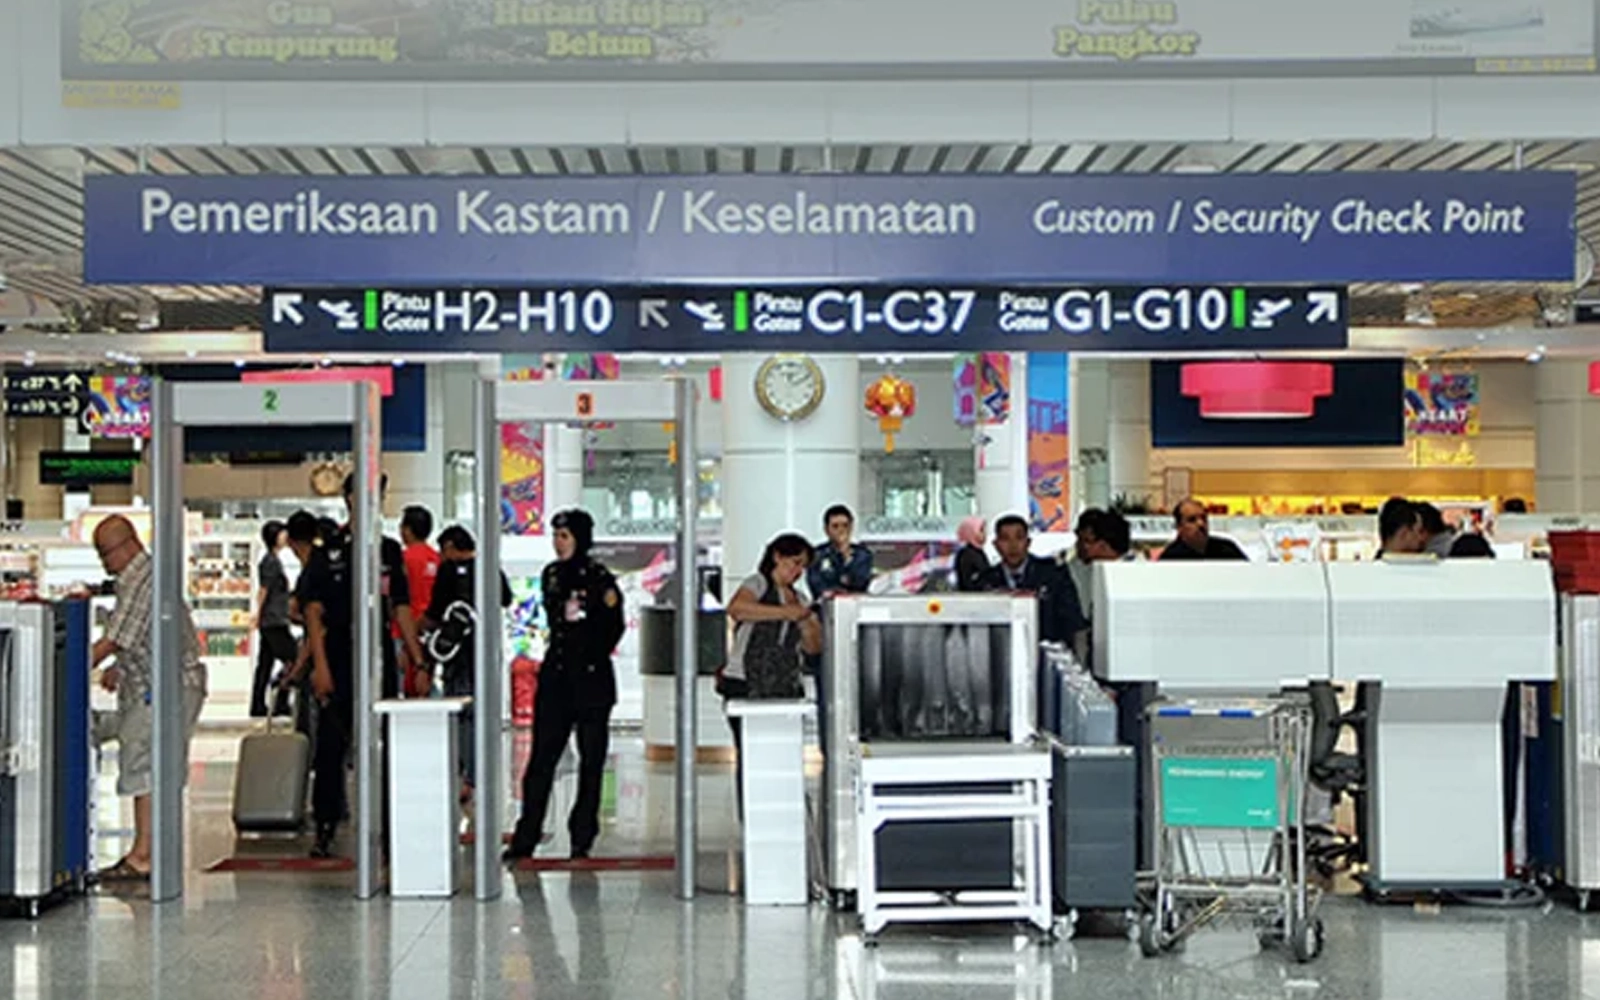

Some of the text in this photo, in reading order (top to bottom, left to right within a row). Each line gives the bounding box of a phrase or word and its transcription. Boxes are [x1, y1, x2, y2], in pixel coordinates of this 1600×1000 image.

[493, 0, 706, 30] Hutan Hujan
[1077, 0, 1176, 24] Pulau
[203, 31, 397, 62] Tempurung
[546, 30, 653, 57] Belum
[1055, 28, 1198, 60] Pangkor
[141, 189, 976, 235] Pemeriksaan Kastam / Keselamatan
[1033, 200, 1524, 242] Custom / Security Check Point
[382, 291, 430, 312] Pintu
[435, 290, 613, 333] H2-H10
[754, 292, 803, 312] Pintu
[807, 290, 976, 333] C1-C37
[1053, 288, 1227, 332] G1-G10
[382, 311, 430, 332] Gates
[753, 313, 803, 332] Gates
[1000, 312, 1049, 331] Gates
[264, 388, 278, 411] 2
[578, 392, 592, 415] 3
